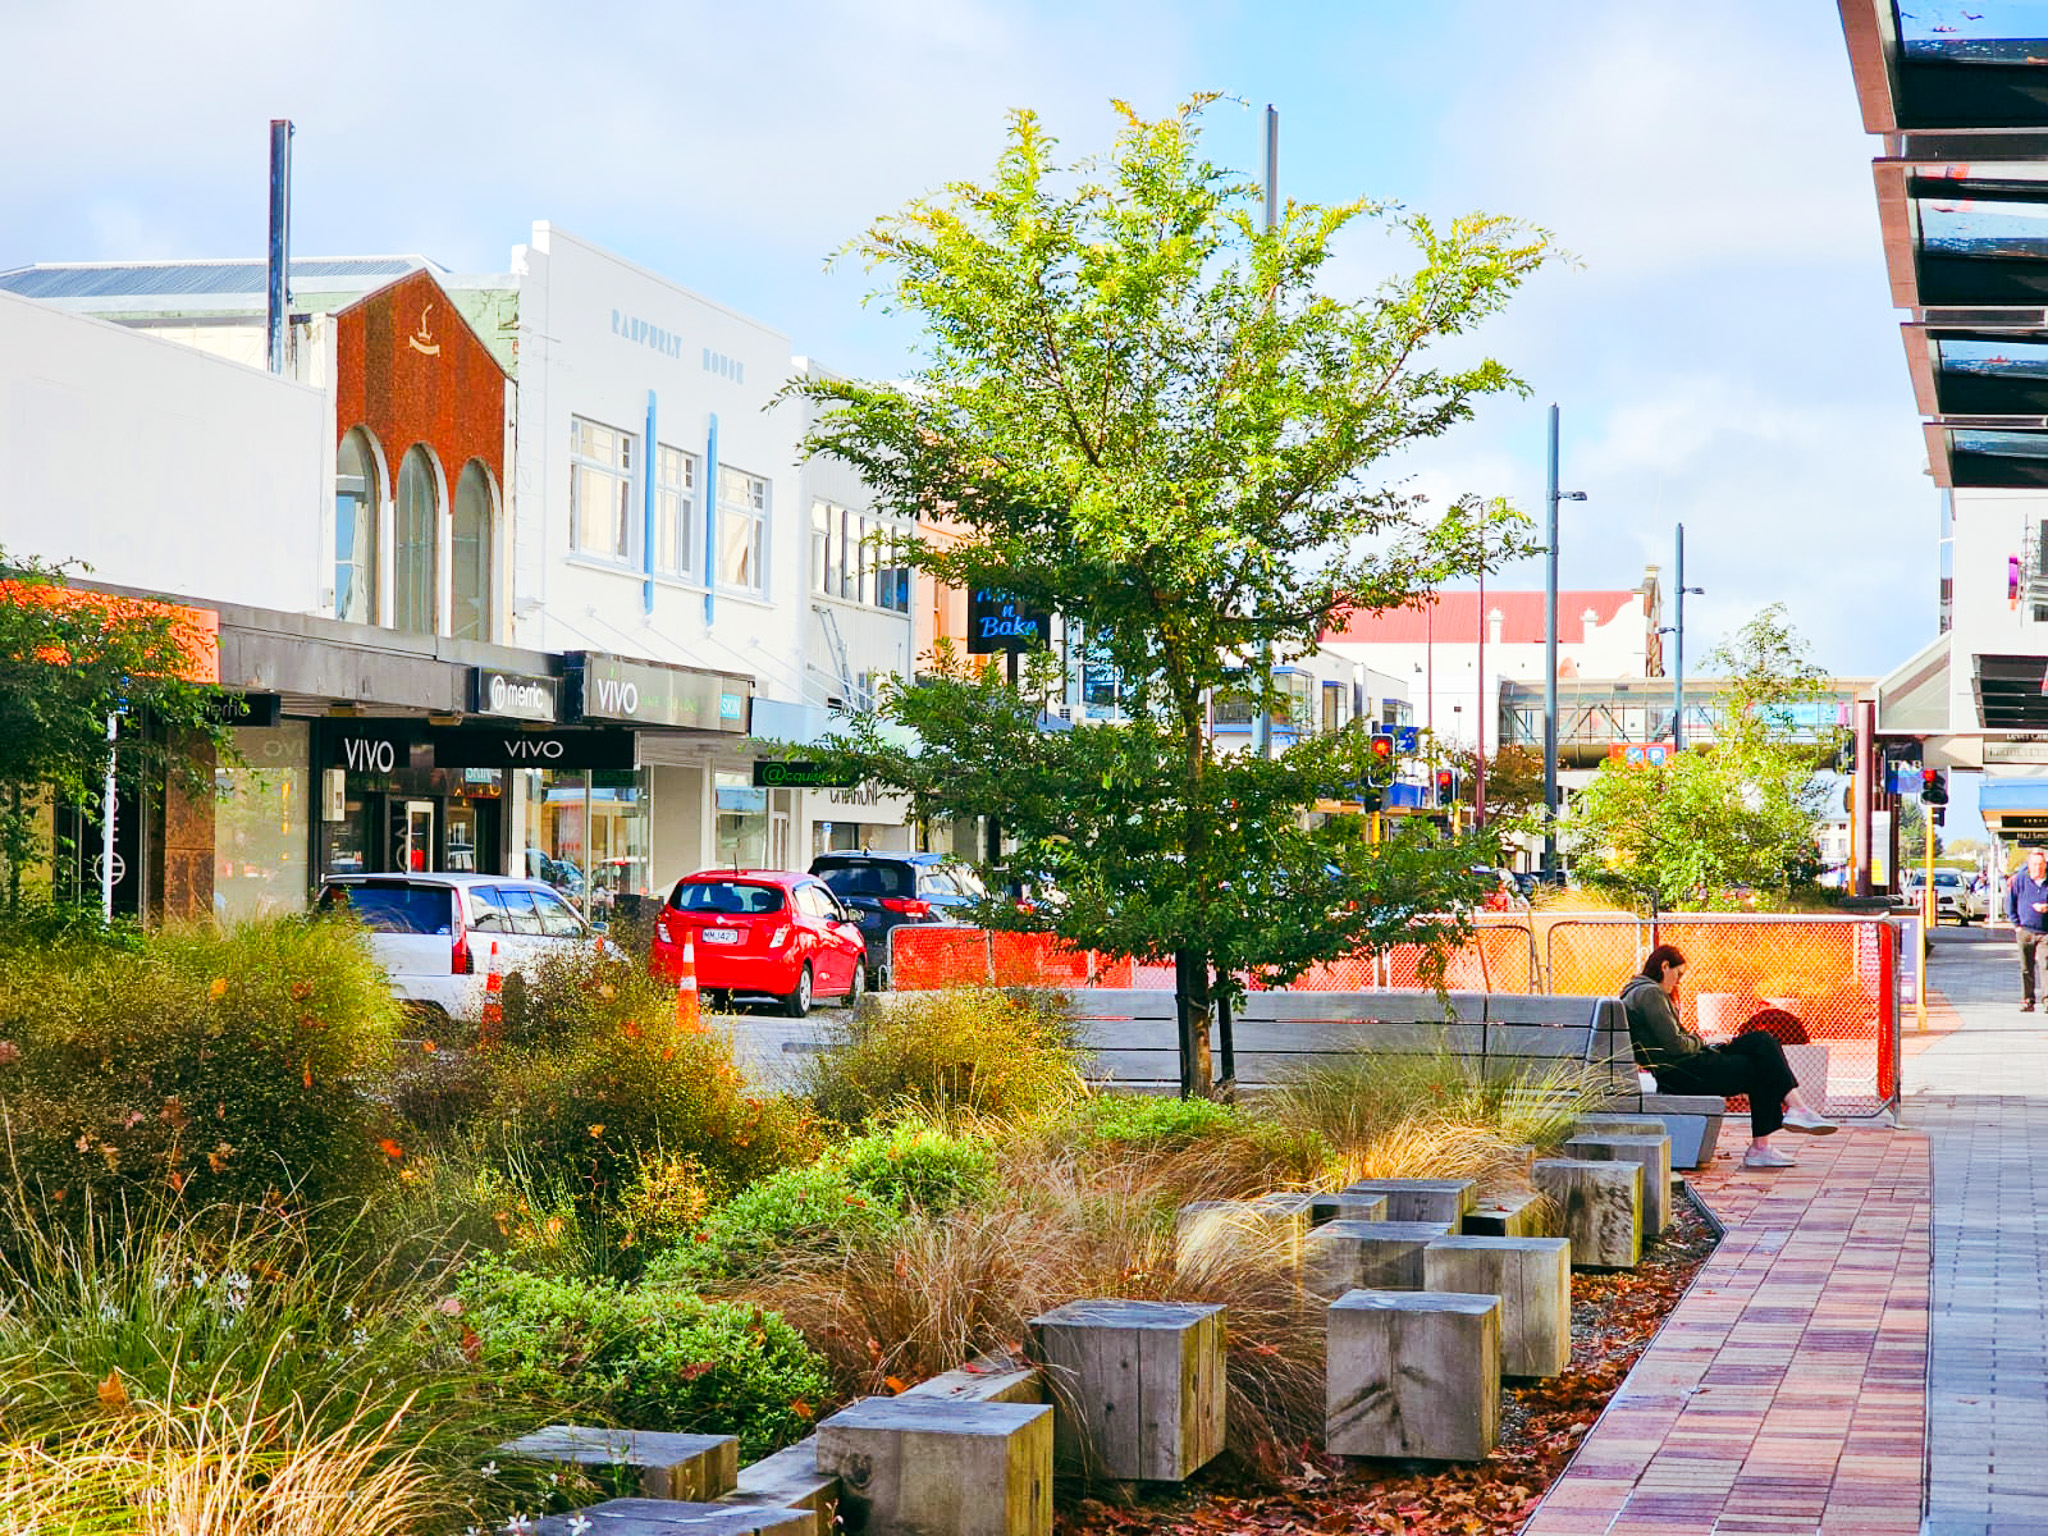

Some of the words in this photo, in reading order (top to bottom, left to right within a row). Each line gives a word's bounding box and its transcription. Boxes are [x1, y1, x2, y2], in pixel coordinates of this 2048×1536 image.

[979, 616, 1037, 638] Bake
[507, 681, 544, 709] merric
[597, 677, 639, 715] VIVO
[344, 738, 395, 773] VIVO
[504, 740, 564, 759] VIVO
[1887, 759, 1923, 772] TAB
